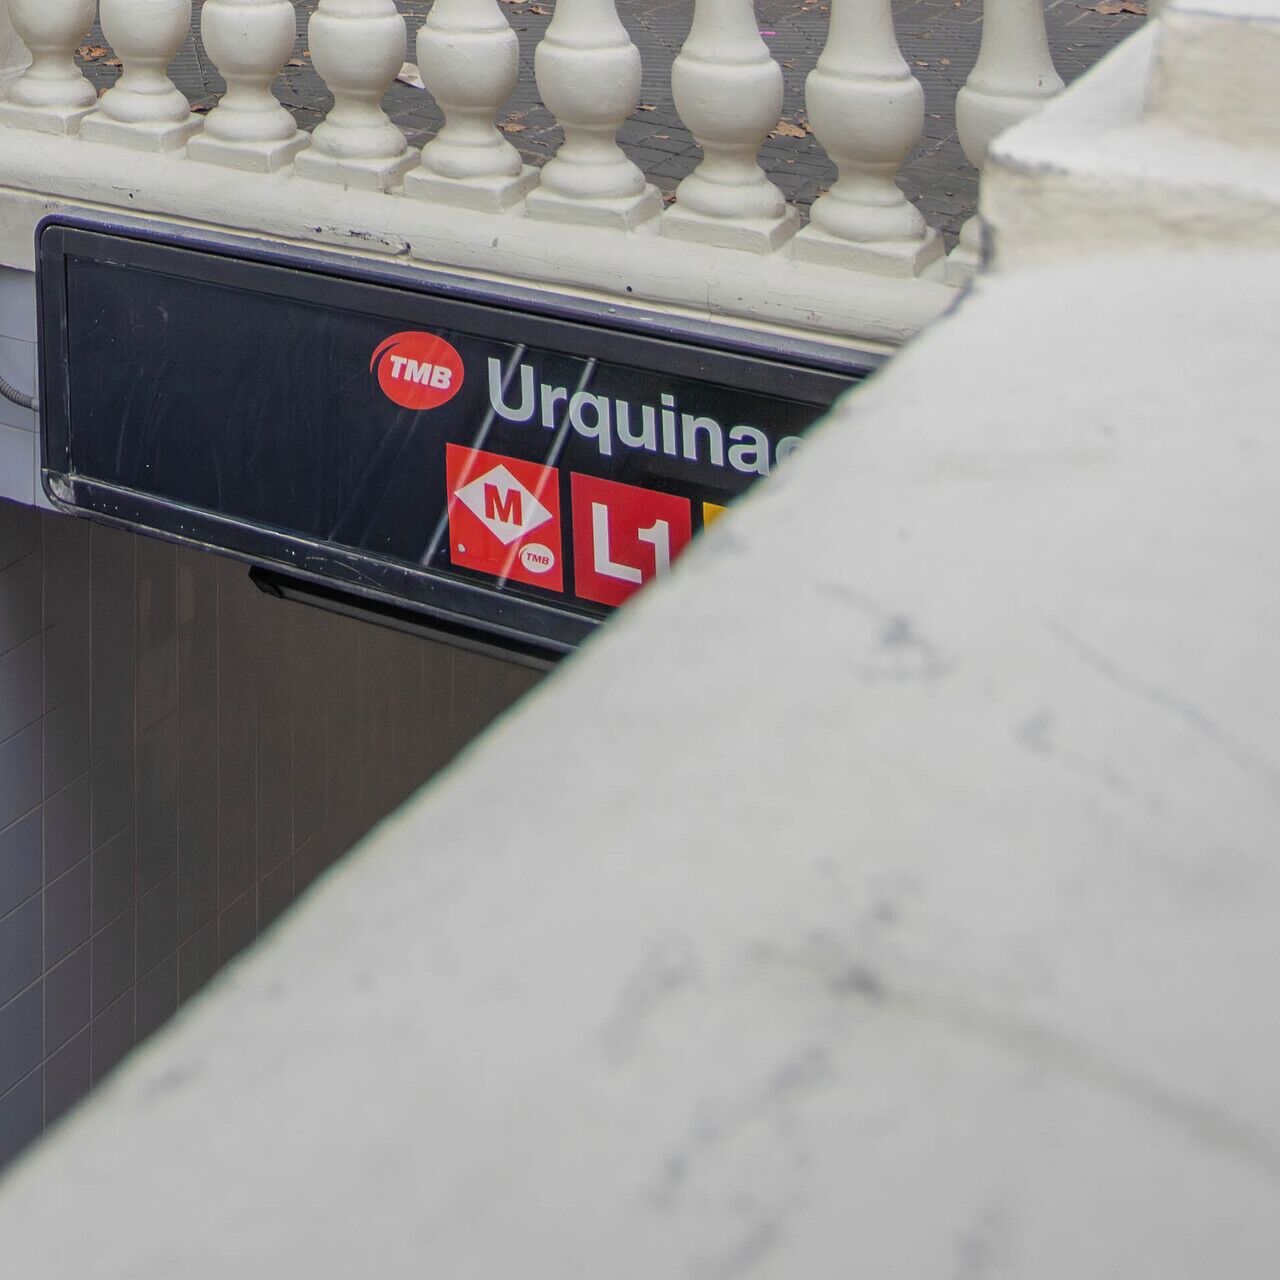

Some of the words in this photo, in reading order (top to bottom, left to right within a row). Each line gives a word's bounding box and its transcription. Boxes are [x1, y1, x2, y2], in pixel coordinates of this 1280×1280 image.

[389, 354, 453, 391] TMB
[483, 482, 523, 527] M
[525, 552, 550, 566] TMB
[591, 501, 671, 585] L1
